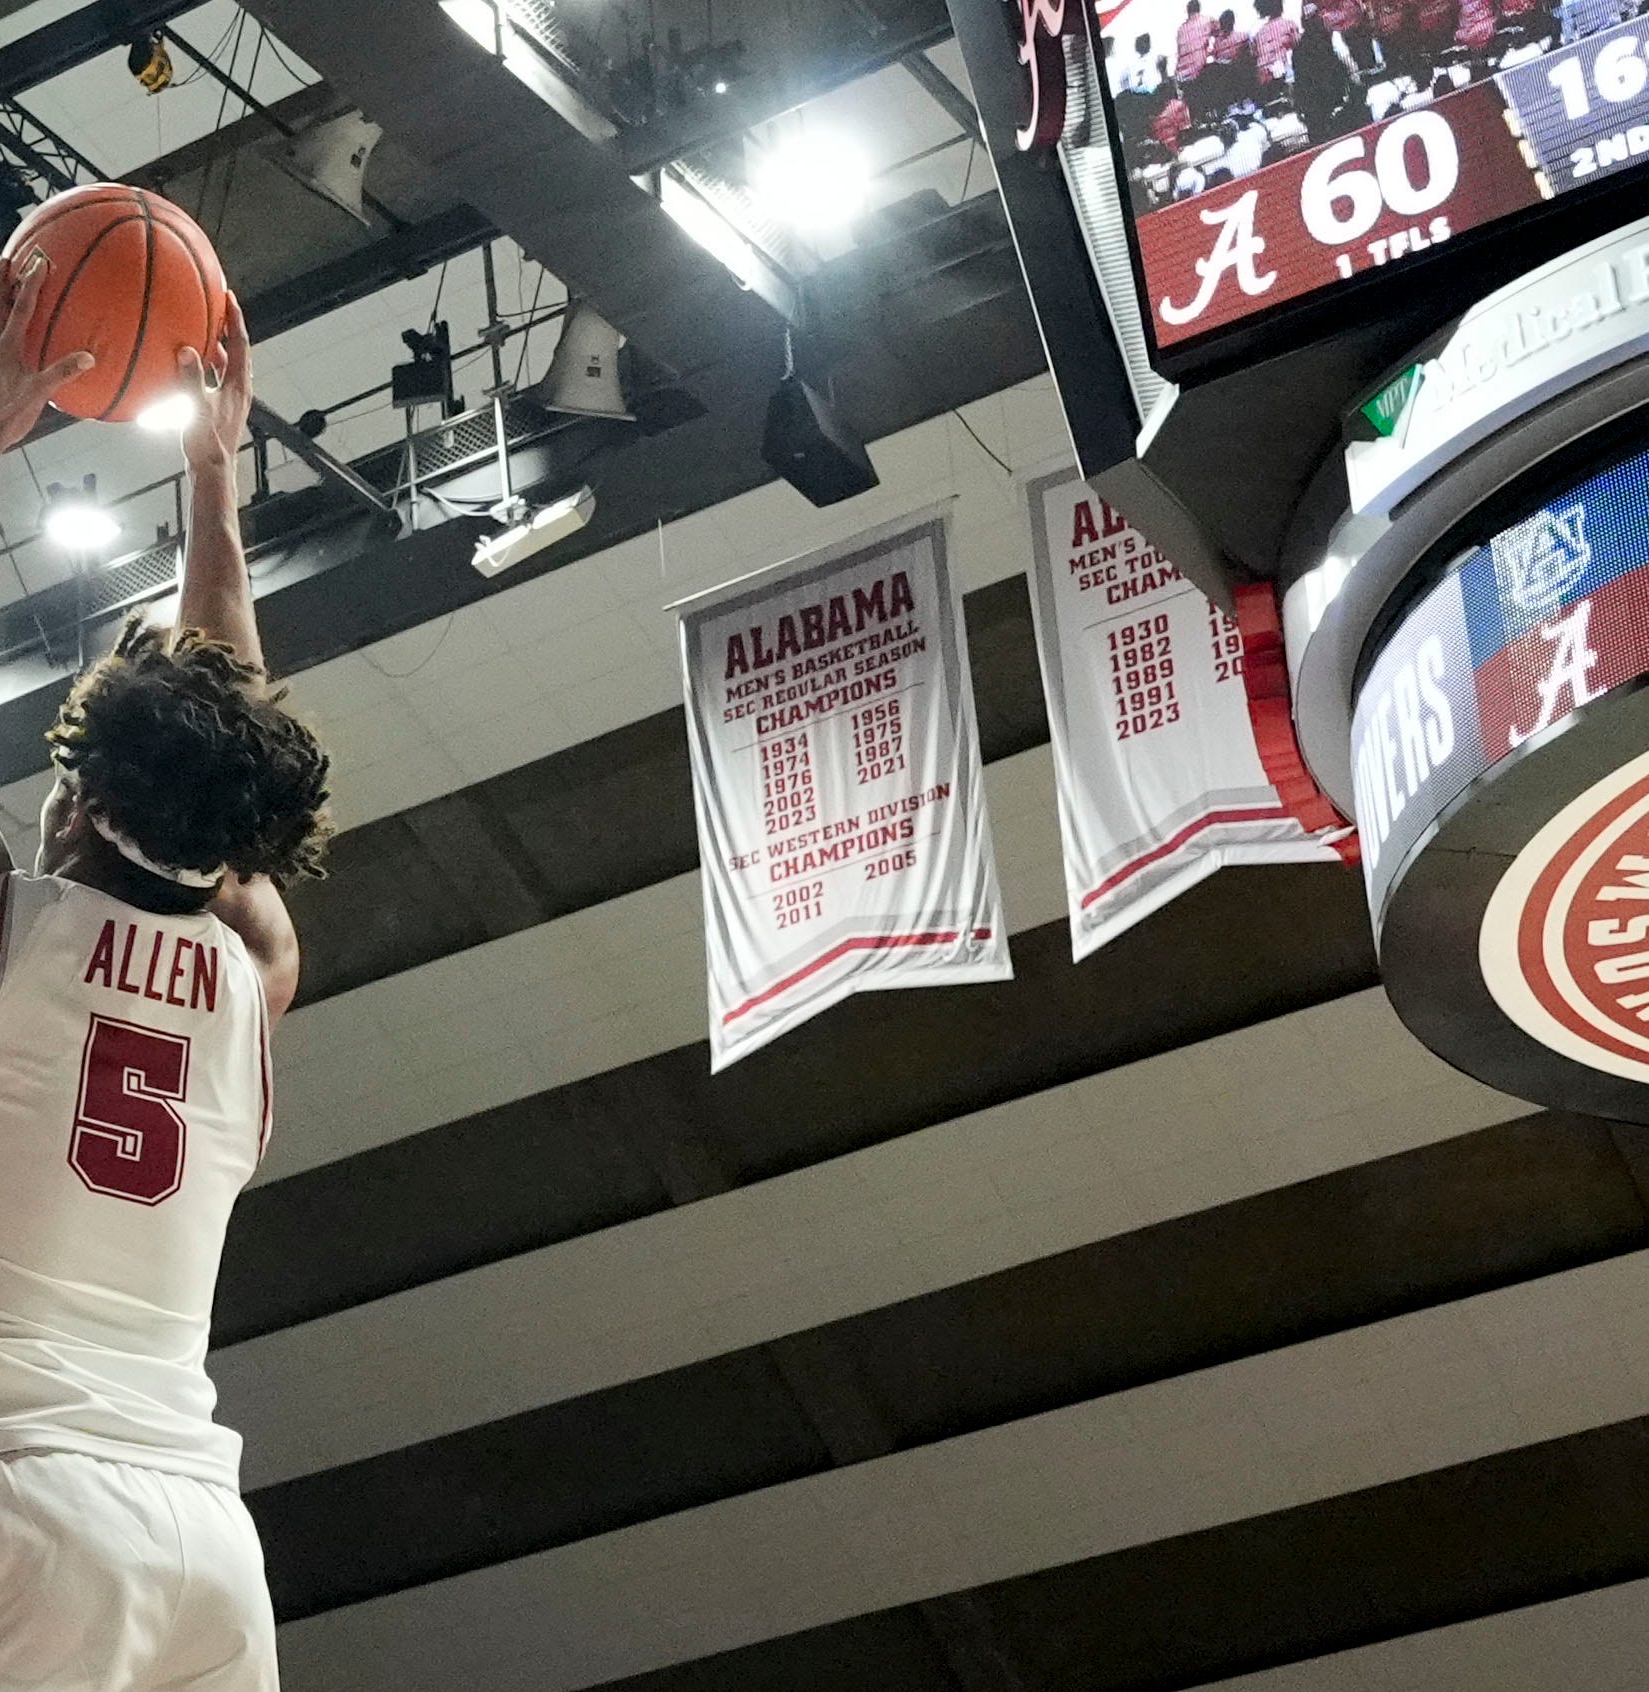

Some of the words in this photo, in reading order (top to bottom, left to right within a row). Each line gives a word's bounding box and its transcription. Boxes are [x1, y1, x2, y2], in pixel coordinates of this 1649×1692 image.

[1300, 109, 1459, 245] 60
[1159, 190, 1278, 326] A
[1068, 537, 1136, 574] MEN'S
[1078, 565, 1118, 591] SEC
[724, 571, 915, 680] ALABAMA
[1107, 613, 1169, 651] 1930
[726, 669, 786, 703] MEN'S
[792, 619, 920, 680] BASKETBALL
[1109, 636, 1172, 673] 1982
[723, 701, 756, 724] SEC
[763, 667, 848, 710] REGULAR
[854, 636, 926, 676] SEASON
[1112, 658, 1175, 695] 1989
[756, 668, 897, 735] CHAMPIONS
[850, 699, 900, 731] 1956
[1115, 681, 1175, 716] 1991
[853, 716, 902, 749] 1975
[1116, 702, 1181, 741] 2023
[760, 732, 809, 763] 1934
[761, 752, 810, 780] 1974
[854, 735, 903, 767] 1987
[763, 769, 812, 799] 1976
[857, 753, 906, 785] 2021
[764, 787, 815, 817] 2002
[765, 804, 817, 835] 2023
[729, 849, 760, 872] SEC
[767, 816, 861, 859] WESTERN
[868, 782, 951, 825] DIVISION
[769, 817, 914, 883] CHAMPIONS
[864, 850, 917, 881] 2005
[773, 880, 824, 912] 2002
[776, 901, 822, 930] 2011
[84, 919, 219, 1013] ALLEN
[67, 1011, 191, 1207] 5
